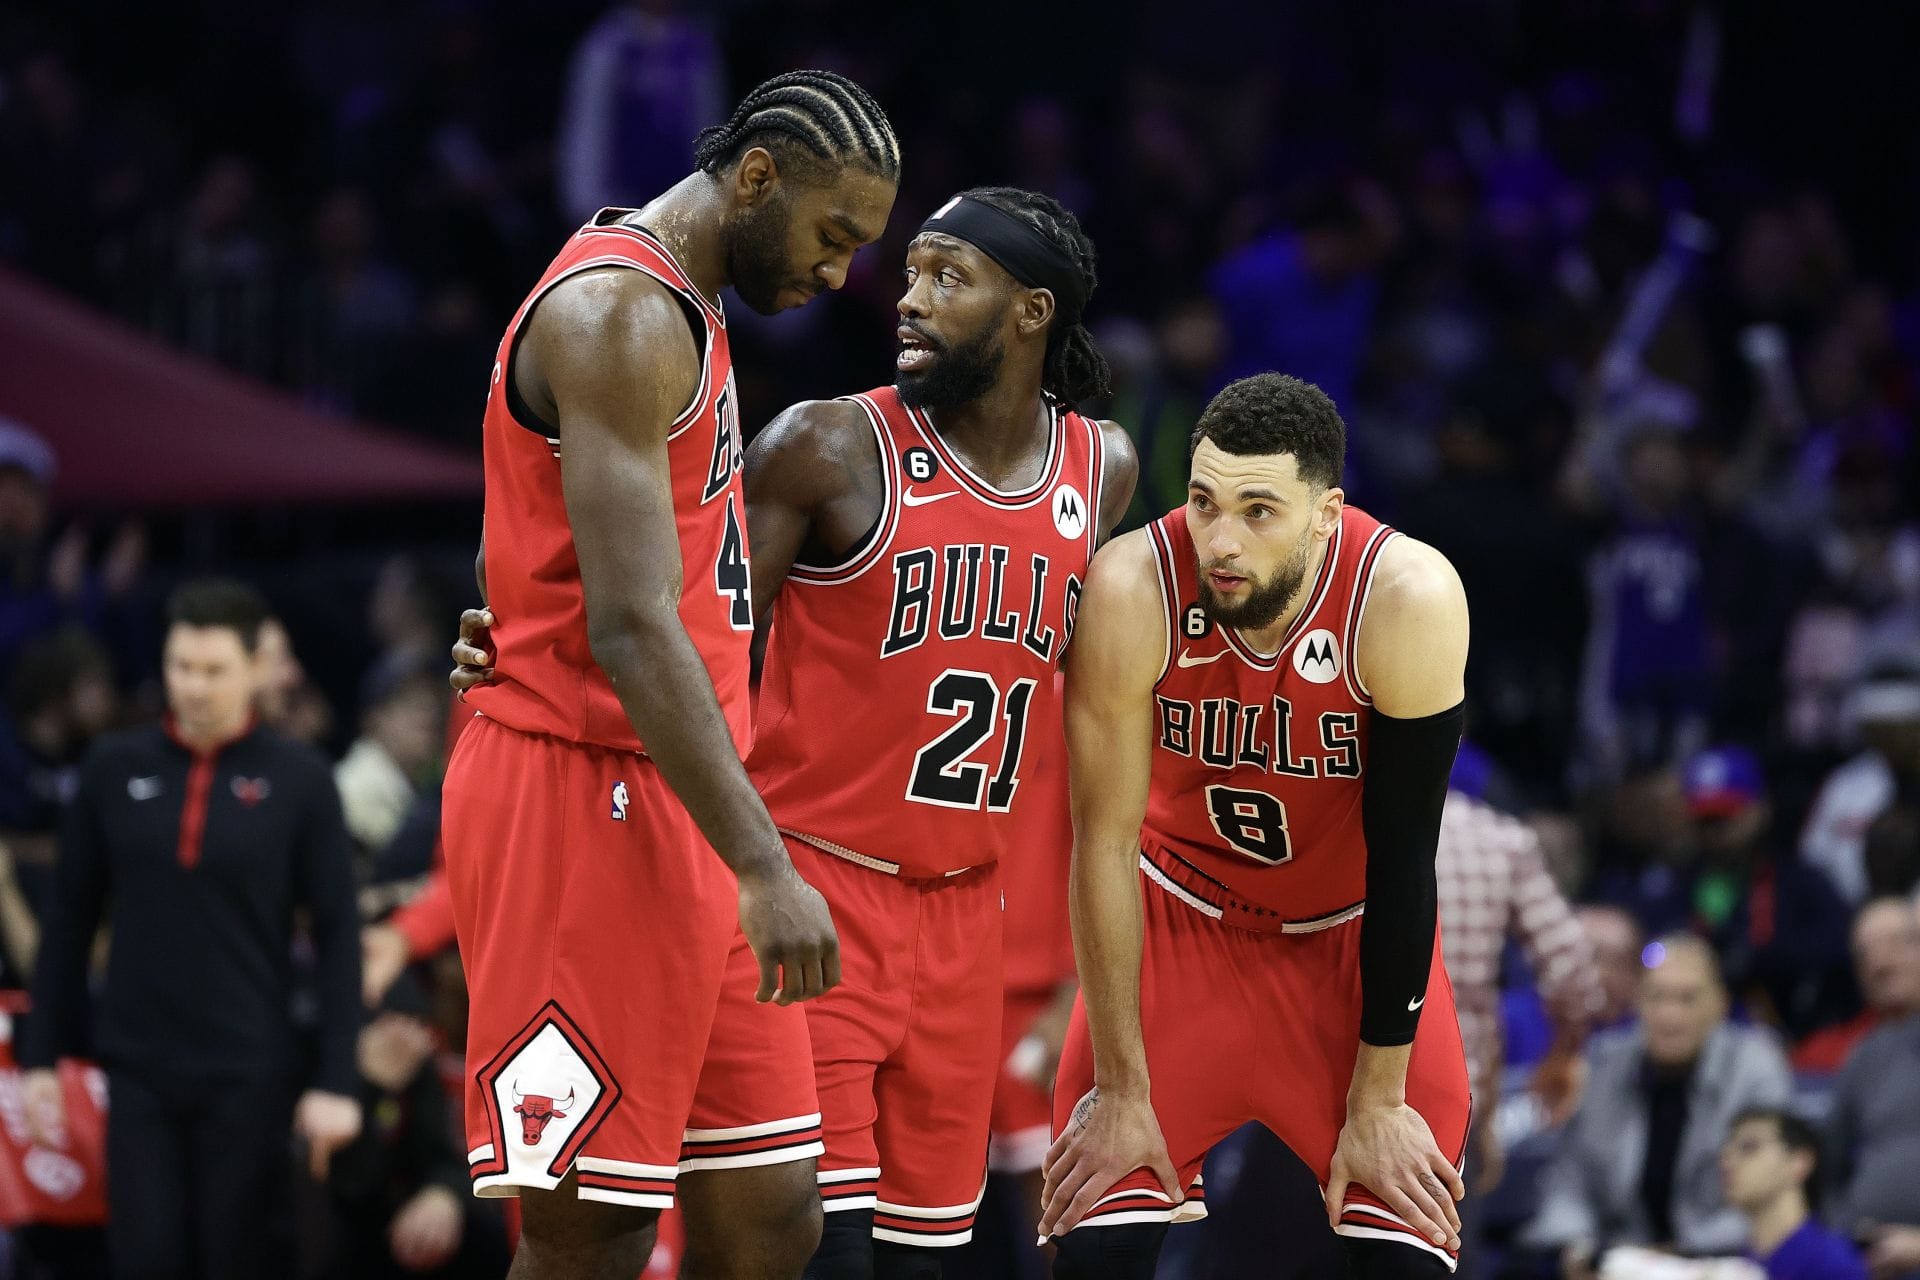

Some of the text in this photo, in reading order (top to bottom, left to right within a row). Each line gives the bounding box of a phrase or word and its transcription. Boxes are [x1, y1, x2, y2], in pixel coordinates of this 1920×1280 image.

[910, 451, 930, 479] 6
[1187, 607, 1205, 635] 6
[905, 667, 1039, 814] 21
[1156, 694, 1363, 780] BULLS
[1205, 783, 1293, 866] 8
